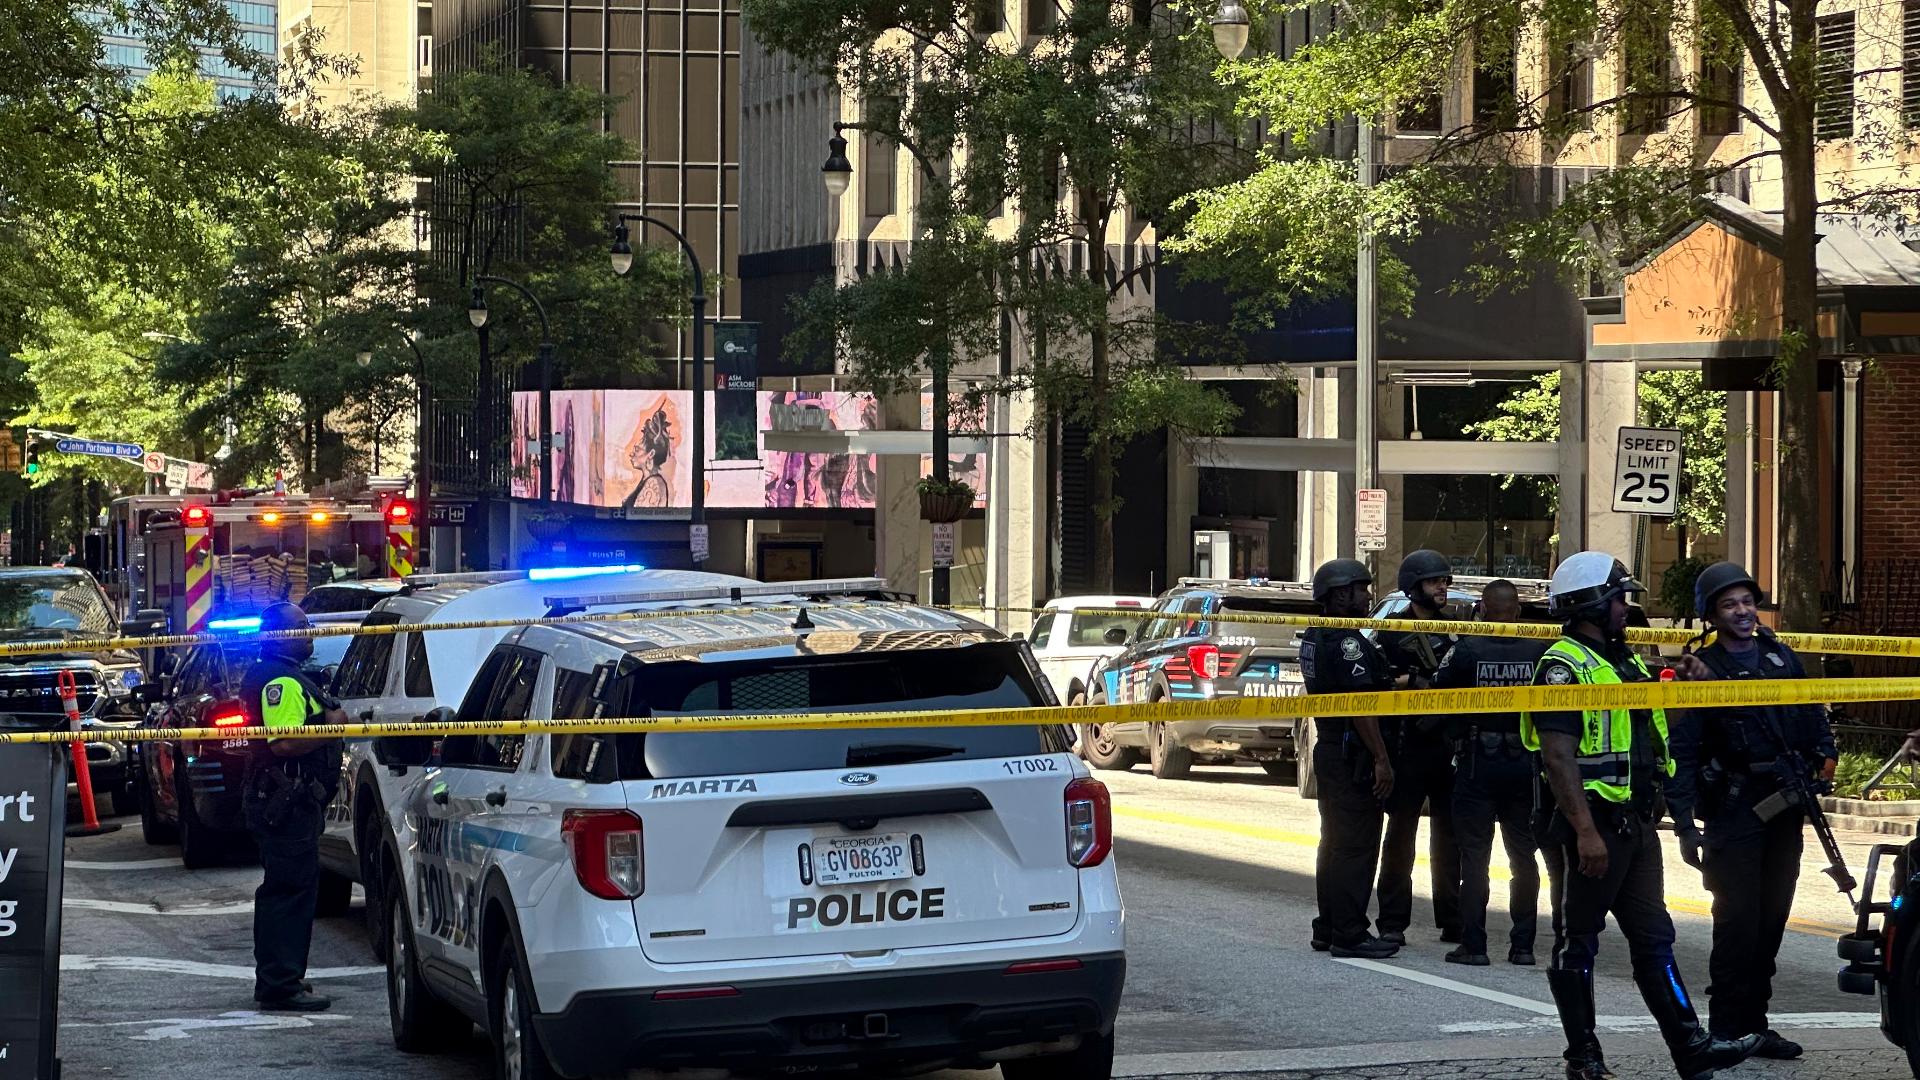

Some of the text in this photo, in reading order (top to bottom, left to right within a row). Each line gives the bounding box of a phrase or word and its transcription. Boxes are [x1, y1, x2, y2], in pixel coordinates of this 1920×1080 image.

[67, 441, 84, 451] John
[85, 442, 114, 454] Portman
[116, 445, 131, 456] Blvd
[1624, 438, 1676, 452] SPEED
[1627, 455, 1669, 469] LIMIT
[171, 471, 184, 479] WAY
[1621, 472, 1669, 503] 25
[1360, 491, 1368, 500] NO
[1822, 637, 1900, 653] POLICE LINE DO NOT CROSS
[1480, 664, 1532, 679] ATLANTA
[222, 738, 249, 749] 3585
[1002, 757, 1058, 777] 17002
[846, 773, 871, 784] Ford
[651, 777, 758, 799] MARTA
[834, 837, 885, 849] GEORGIA
[827, 845, 903, 872] GV0863P
[849, 870, 883, 879] FULTON
[787, 886, 945, 930] POLICE
